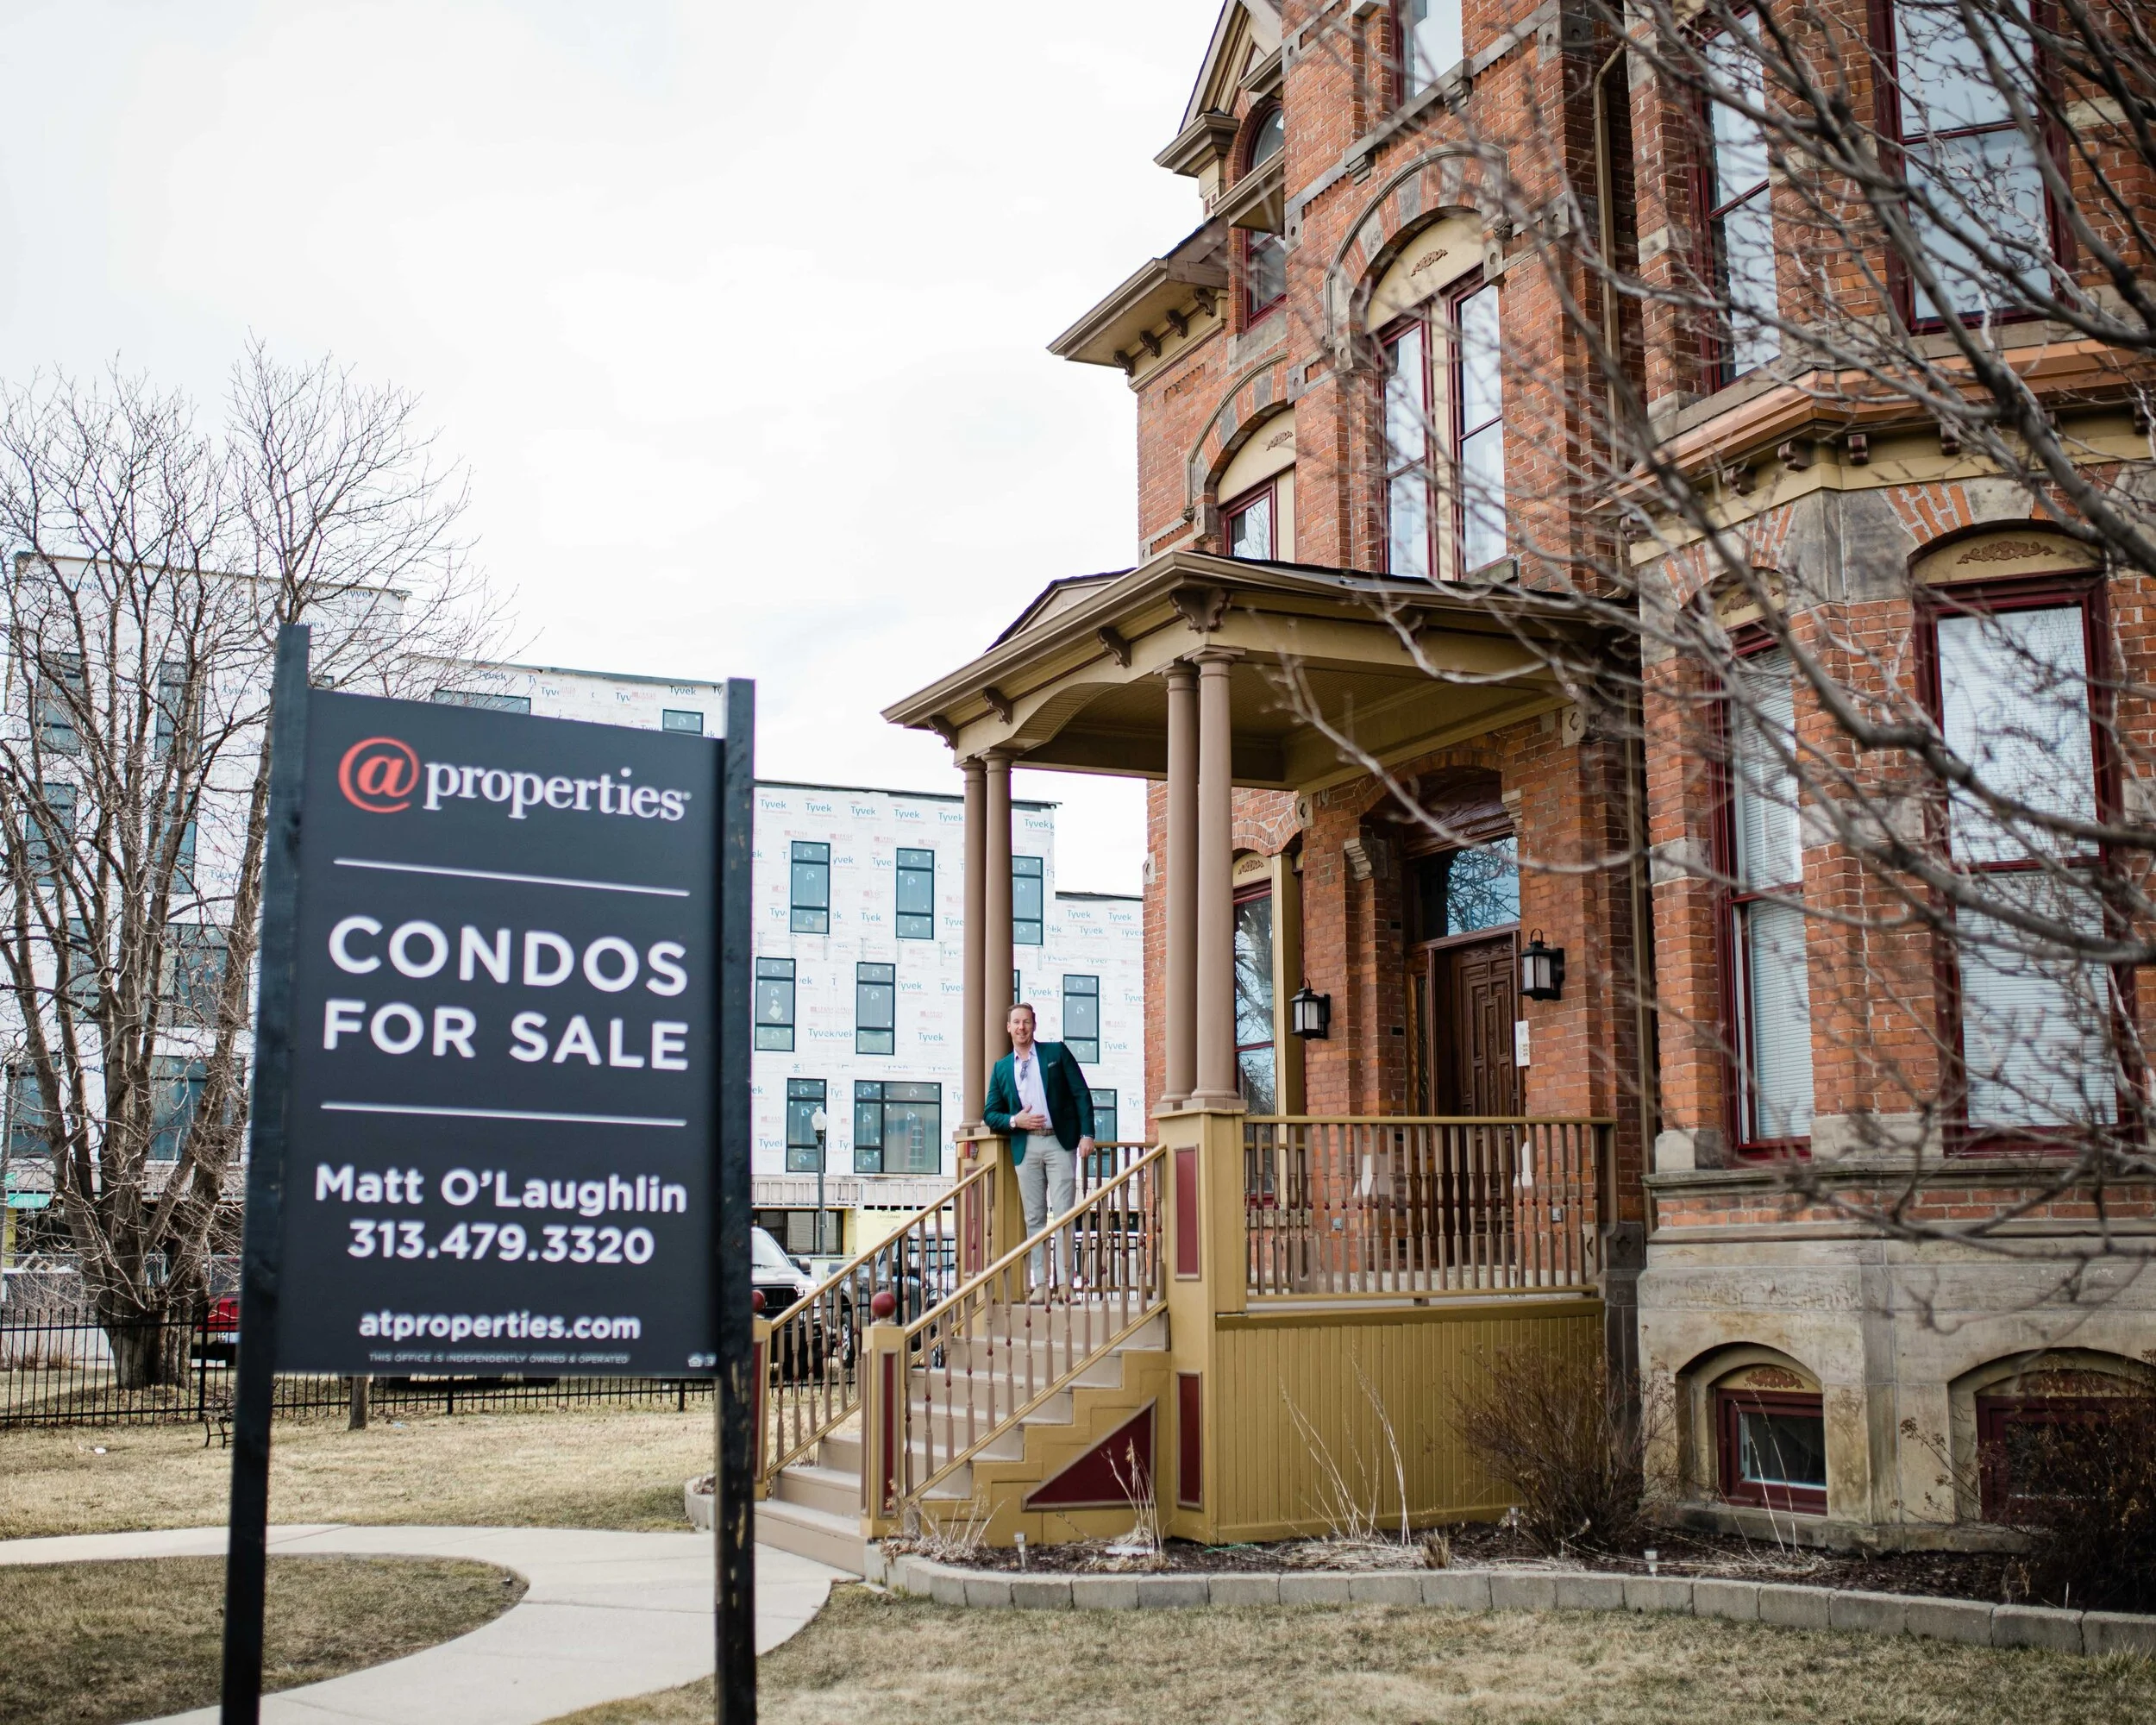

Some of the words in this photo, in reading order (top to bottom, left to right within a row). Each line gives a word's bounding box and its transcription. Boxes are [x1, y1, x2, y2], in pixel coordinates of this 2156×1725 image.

[542, 687, 560, 698] Tyv
[669, 685, 696, 695] Tyvek
[615, 692, 631, 702] Tyv
[337, 736, 689, 821] @properties
[760, 799, 787, 809] Tyvek
[805, 802, 832, 812] Tyvek
[850, 806, 876, 816] Tyvek
[894, 809, 920, 819] Tyvek
[938, 812, 963, 822] Tyvek
[1025, 819, 1049, 828] Tyvek
[832, 856, 854, 864] yvek
[872, 856, 892, 867] Tyve
[769, 907, 787, 919] Tyv
[1067, 909, 1091, 919] Tyvek
[1108, 912, 1132, 921] Tyvek
[944, 917, 964, 927] Tyve
[329, 915, 688, 996] CONDOS
[1028, 987, 1052, 997] Tyvek
[1125, 994, 1143, 1002] Tyve
[323, 998, 476, 1058] FOR
[509, 1011, 688, 1070] SALE
[918, 1032, 943, 1042] Tyvek
[1104, 1041, 1128, 1051] Tyvek
[315, 1163, 424, 1205] Matt
[441, 1168, 687, 1217] O'Laughlin
[347, 1220, 655, 1264] 313.479.3320
[359, 1309, 642, 1341] atproperties.com
[369, 1353, 392, 1362] THIS
[394, 1353, 430, 1363] OFFICE
[434, 1354, 443, 1363] IS
[446, 1354, 525, 1363] INDEPENDENTLY
[529, 1354, 566, 1363] OWNED
[568, 1354, 575, 1364] &
[578, 1354, 629, 1364] OPERATED
